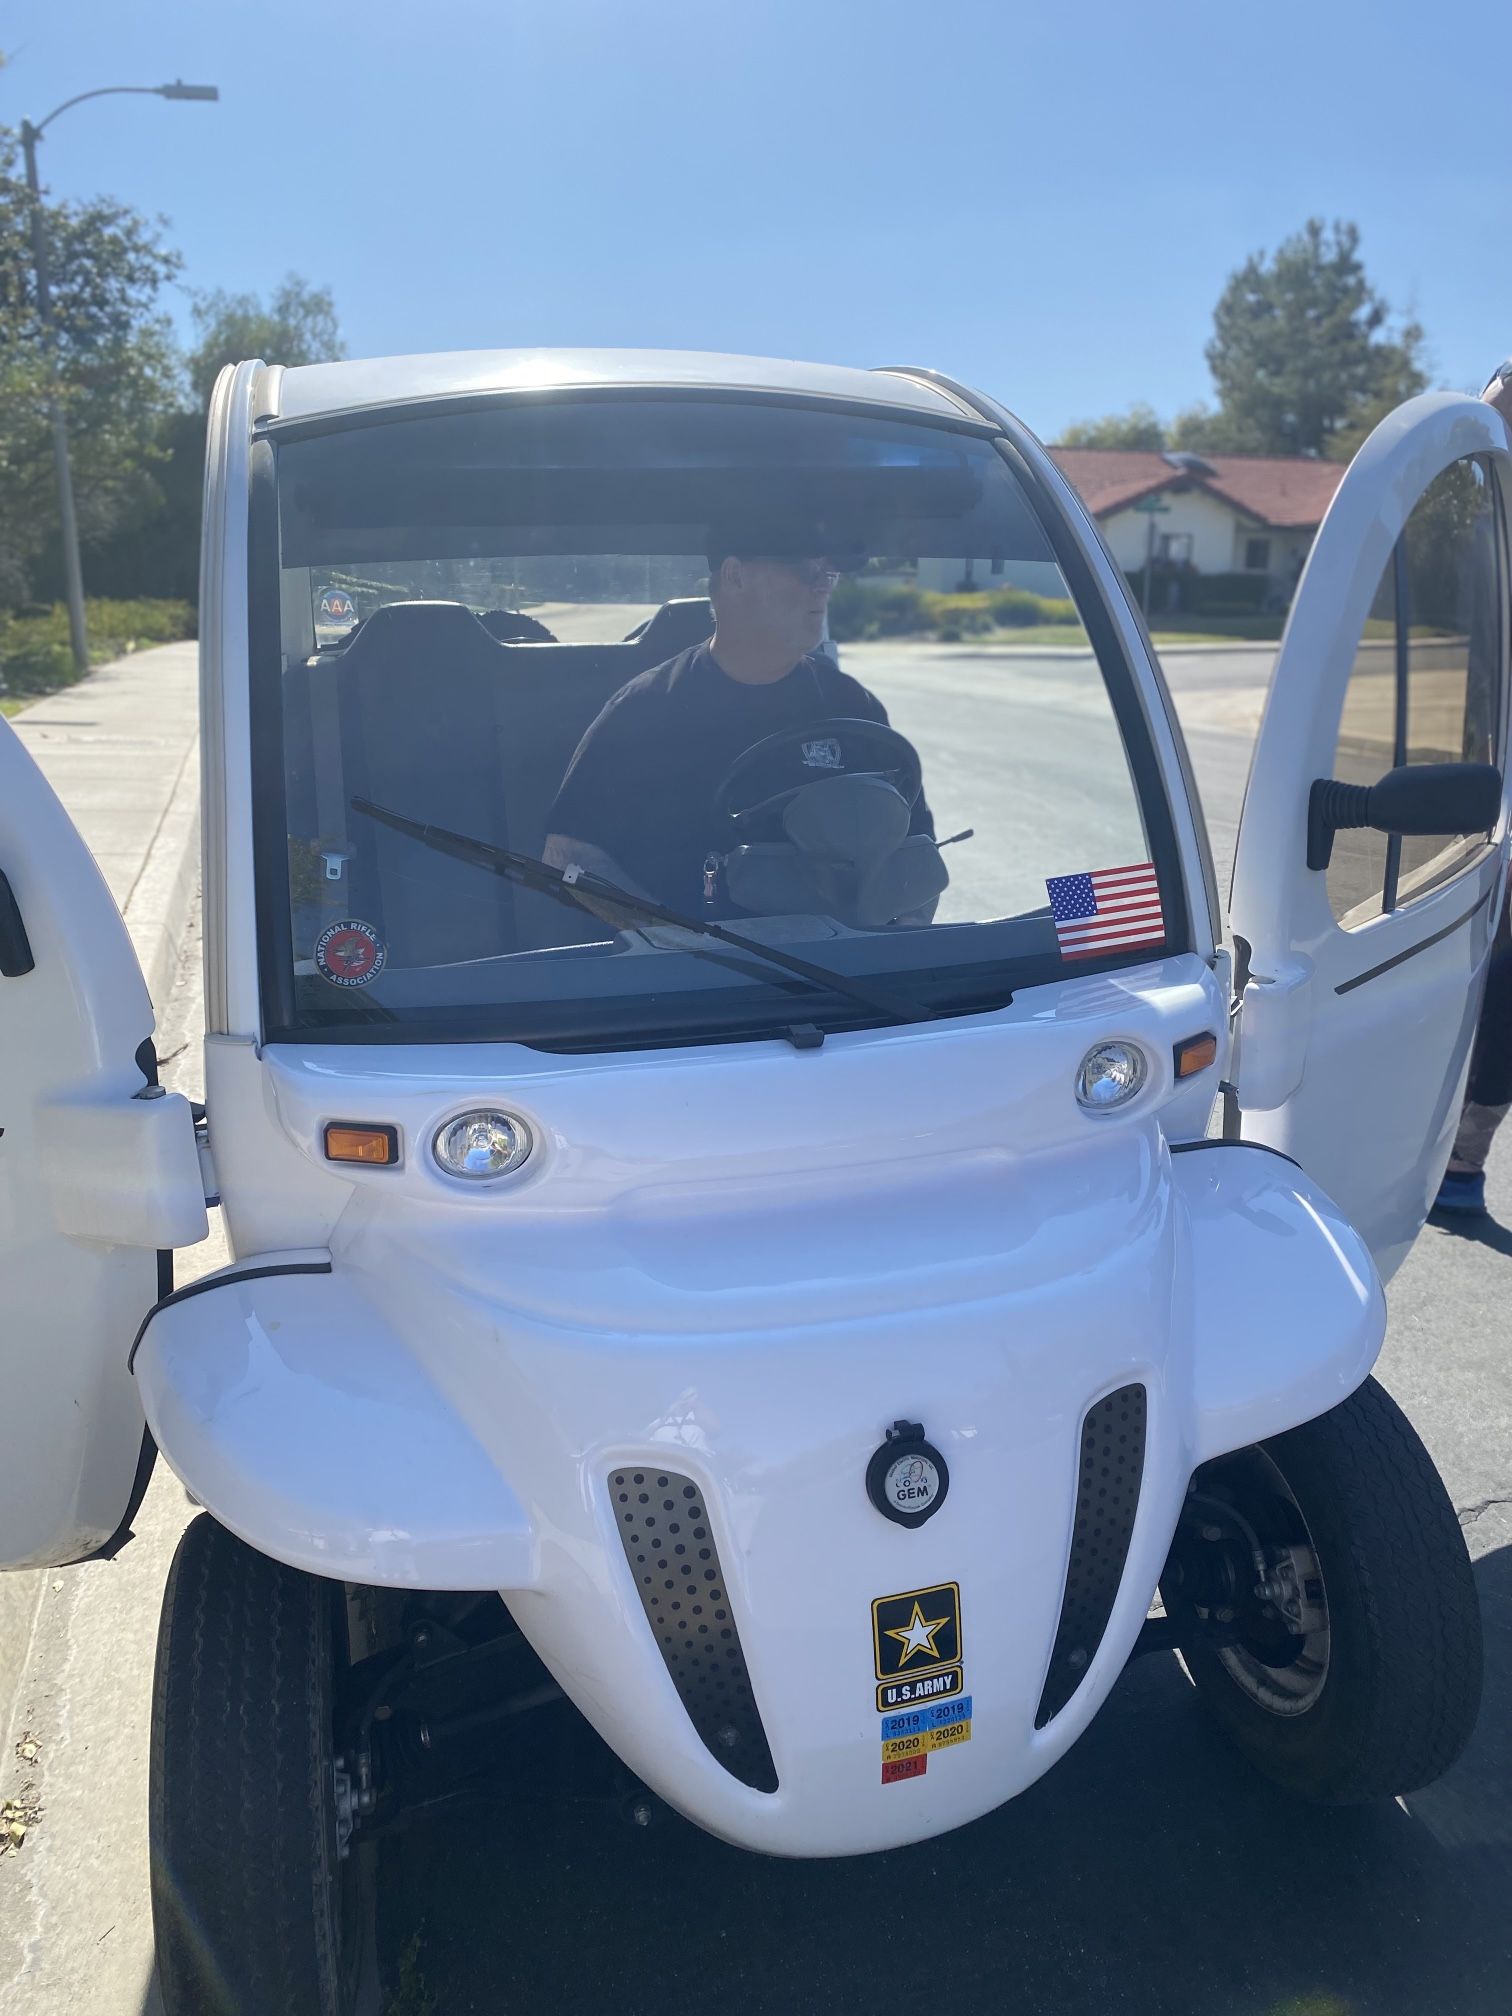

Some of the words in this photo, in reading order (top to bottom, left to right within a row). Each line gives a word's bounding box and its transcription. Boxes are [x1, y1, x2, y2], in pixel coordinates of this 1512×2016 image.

[320, 599, 354, 612] AAA
[317, 923, 348, 966] NATIONAL
[350, 922, 377, 942] RIFLE
[329, 952, 384, 986] ASSOCIATION
[896, 1485, 929, 1501] GEM
[936, 1702, 964, 1719] 2019
[890, 1714, 920, 1730] 2019
[935, 1724, 964, 1741] 2020
[890, 1737, 920, 1753] 2020
[890, 1761, 918, 1775] 2021
